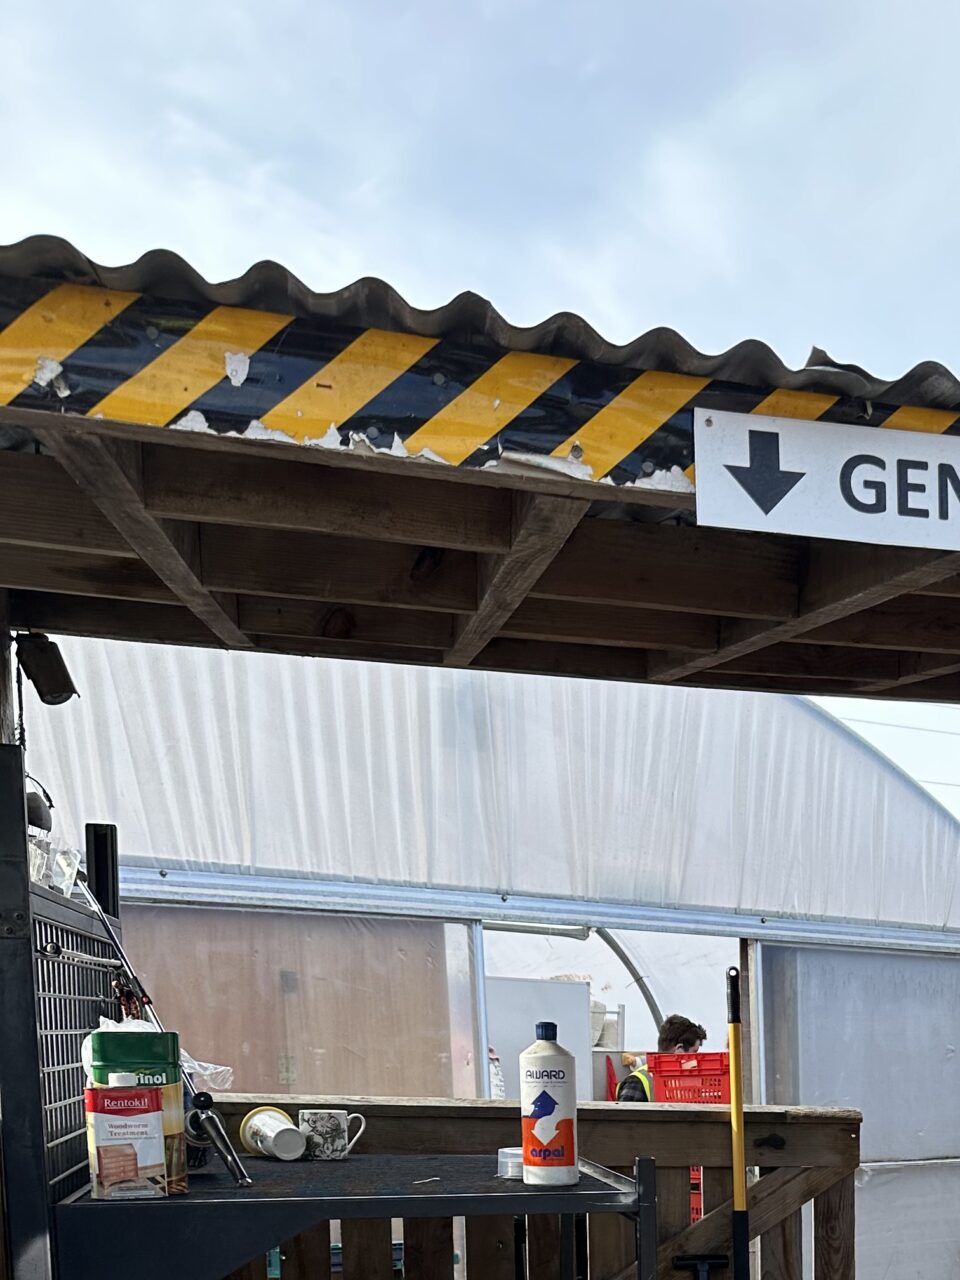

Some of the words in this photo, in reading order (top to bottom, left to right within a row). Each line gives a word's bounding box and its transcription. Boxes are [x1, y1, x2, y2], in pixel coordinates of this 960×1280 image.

[135, 1072, 167, 1085] rinol
[525, 1069, 566, 1080] AWARD
[104, 1098, 149, 1109] Rentokil
[530, 1145, 565, 1161] arpal
